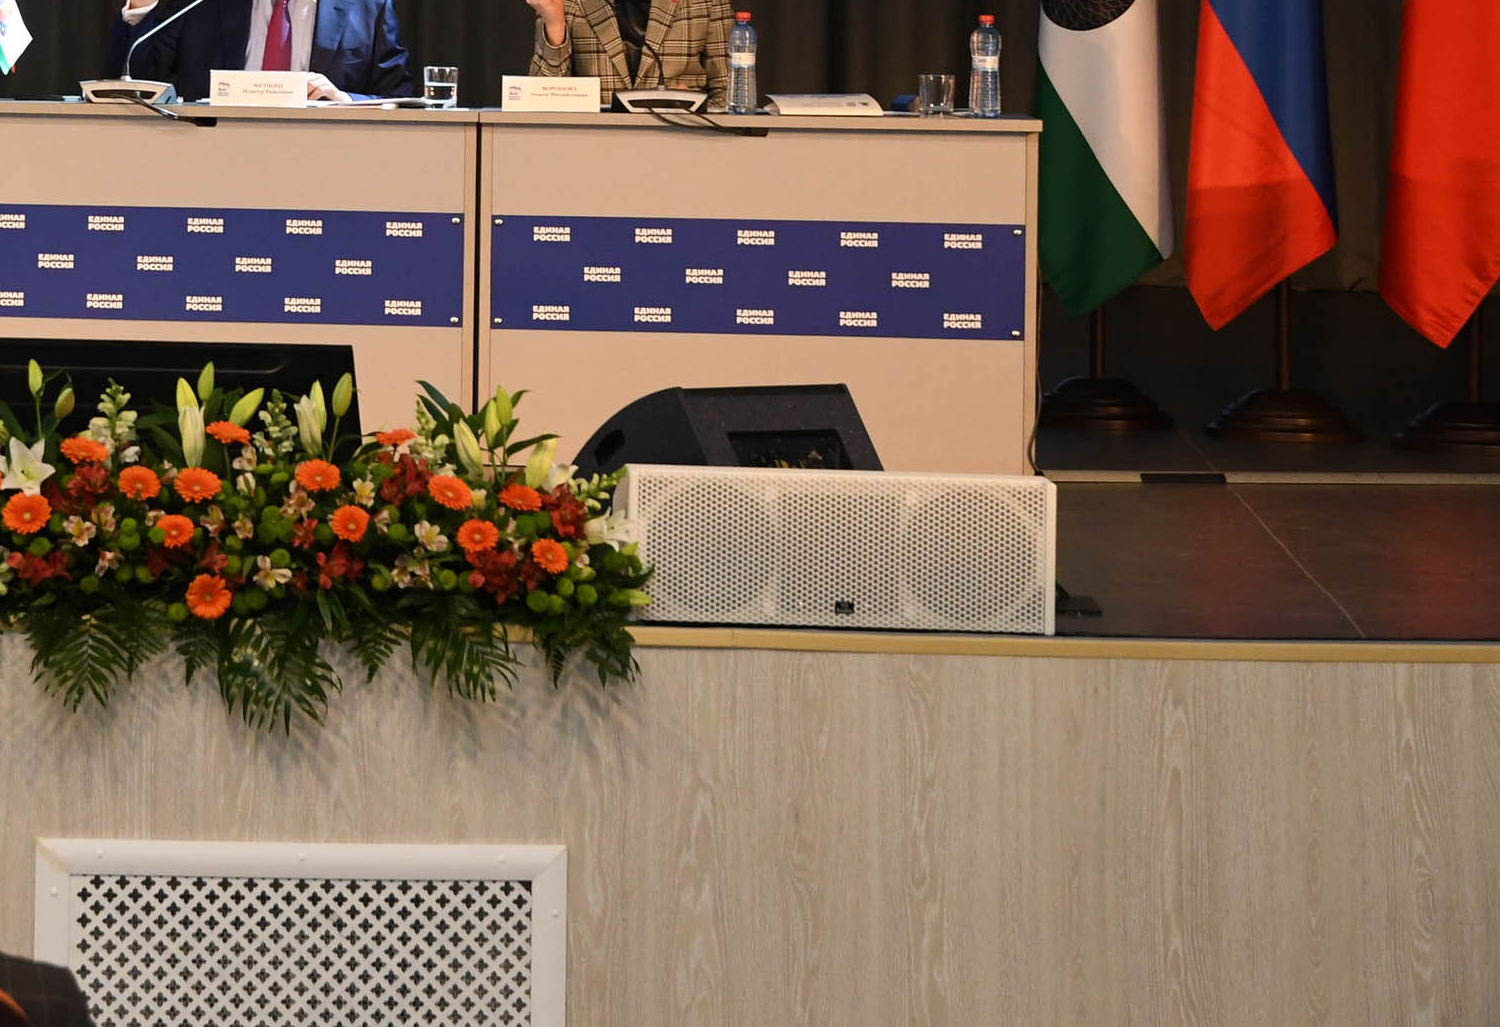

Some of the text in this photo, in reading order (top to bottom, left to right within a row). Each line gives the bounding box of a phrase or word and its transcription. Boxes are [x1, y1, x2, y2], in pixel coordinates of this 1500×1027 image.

[88, 215, 125, 224] ЕДИНАЯ
[188, 217, 224, 226] ЕДИНАЯ
[286, 219, 323, 227] ЕДИНАЯ
[88, 223, 125, 231] РОССИЯ
[188, 225, 224, 234] РОССИЯ
[386, 221, 423, 230] ЕДИНАЯ
[534, 226, 571, 234] ЕДИНАЯ
[286, 226, 323, 235] РОССИЯ
[386, 229, 423, 238] РОССИЯ
[635, 227, 673, 236] ЕДИНАЯ
[738, 229, 775, 238] ЕДИНАЯ
[534, 233, 571, 242] РОССИЯ
[635, 235, 673, 244] РОССИЯ
[841, 231, 879, 240] ЕДИНАЯ
[944, 233, 983, 242] ЕДИНАЯ
[738, 237, 775, 246] РОССИЯ
[841, 239, 879, 248] РОССИЯ
[944, 241, 983, 249] РОССИЯ
[38, 253, 75, 262] ЕДИНАЯ
[137, 255, 174, 264] ЕДИНАЯ
[236, 257, 272, 265] ЕДИНАЯ
[38, 261, 75, 269] РОССИЯ
[137, 263, 174, 271] РОССИЯ
[336, 259, 372, 268] ЕДИНАЯ
[236, 264, 272, 273] РОССИЯ
[335, 267, 372, 276] РОССИЯ
[584, 266, 621, 275] ЕДИНАЯ
[686, 268, 724, 277] ЕДИНАЯ
[584, 274, 621, 283] РОССИЯ
[789, 270, 827, 279] ЕДИНАЯ
[892, 272, 930, 281] ЕДИНАЯ
[686, 276, 723, 284] РОССИЯ
[788, 278, 826, 286] РОССИЯ
[892, 280, 930, 288] РОССИЯ
[87, 293, 124, 302] ЕДИНАЯ
[186, 295, 223, 304] ЕДИНАЯ
[285, 297, 322, 306] ЕДИНАЯ
[87, 301, 123, 310] РОССИЯ
[186, 303, 223, 312] РОССИЯ
[385, 299, 422, 308] ЕДИНАЯ
[285, 305, 321, 313] РОССИЯ
[385, 307, 422, 316] РОССИЯ
[533, 305, 570, 313] ЕДИНАЯ
[634, 306, 672, 315] ЕДИНАЯ
[737, 308, 775, 317] ЕДИНАЯ
[533, 312, 570, 321] РОССИЯ
[634, 314, 672, 323] РОССИЯ
[840, 311, 878, 319] ЕДИНАЯ
[944, 313, 982, 321] ЕДИНАЯ
[737, 316, 774, 325] РОССИЯ
[840, 318, 878, 327] РОССИЯ
[944, 320, 982, 329] РОССИЯ
